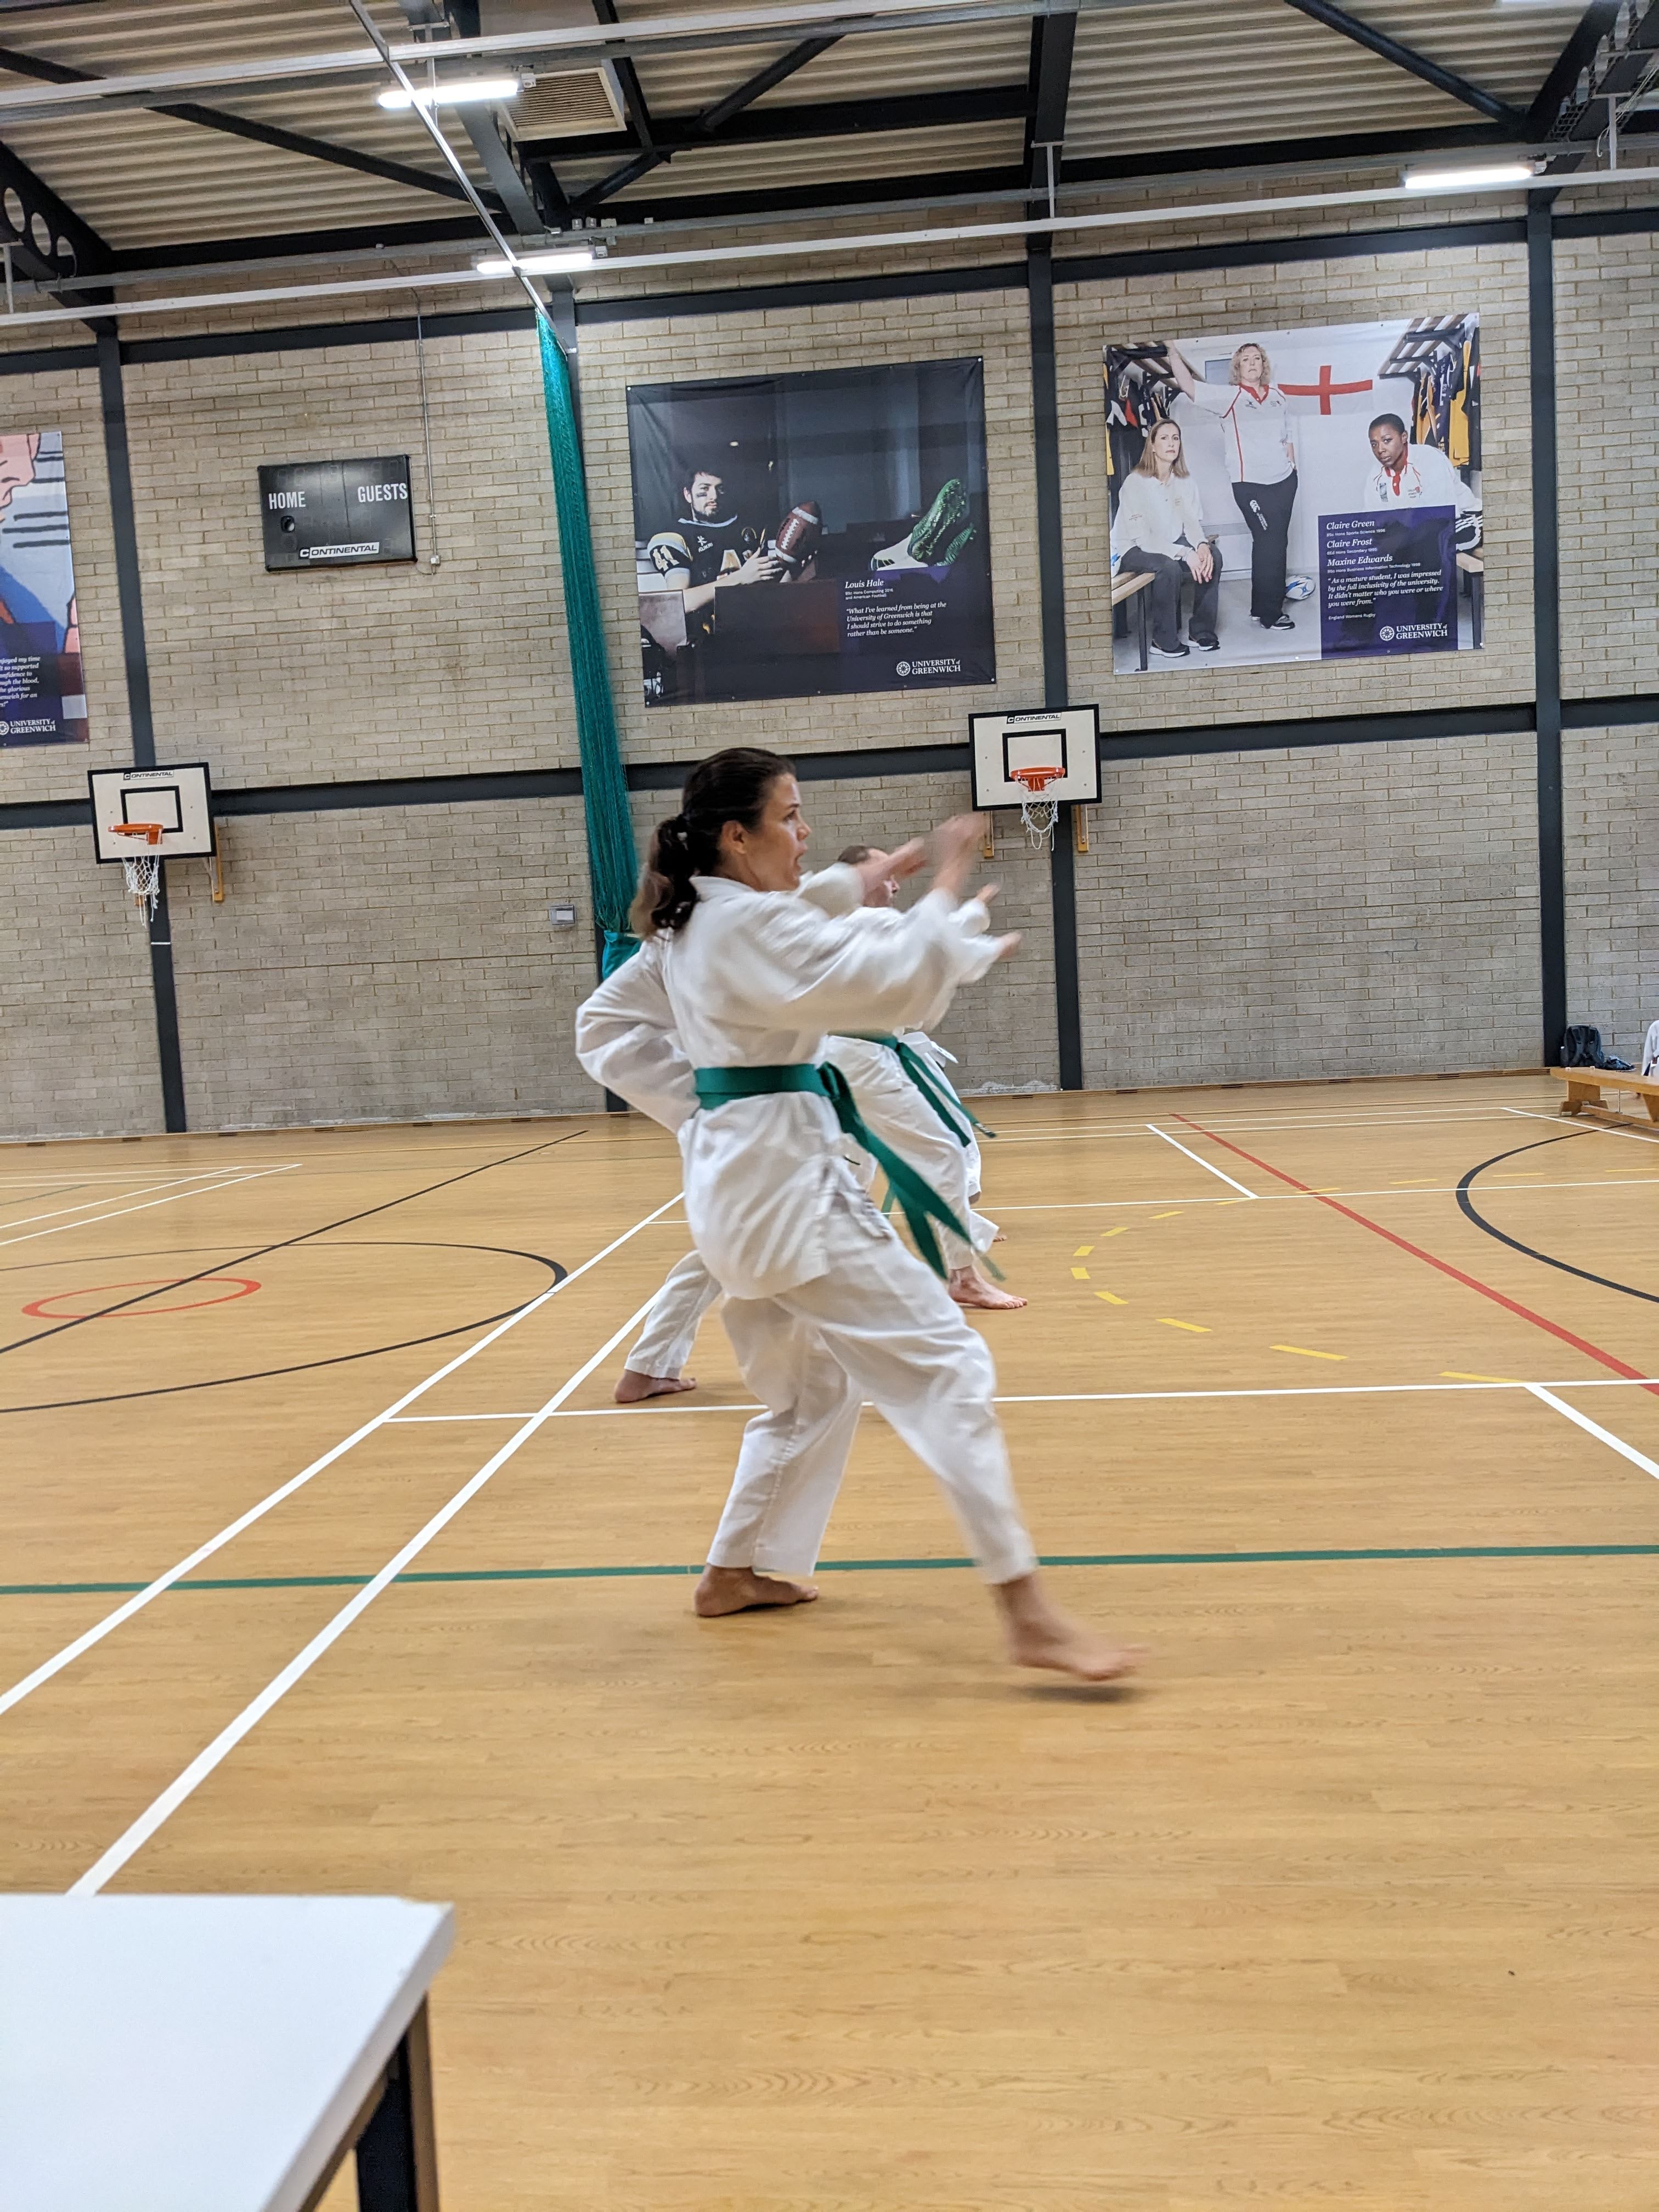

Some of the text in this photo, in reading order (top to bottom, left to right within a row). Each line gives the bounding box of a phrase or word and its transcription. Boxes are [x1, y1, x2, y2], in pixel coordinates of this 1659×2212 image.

[268, 483, 408, 510] HOME GUESTS
[1326, 521, 1350, 530] Claire
[1327, 538, 1373, 548] Claire Frost
[300, 544, 377, 558] CONTINENTAL
[1327, 554, 1393, 567] Maxine Edwards
[1411, 569, 1442, 578] impressed
[845, 578, 884, 589] Louis Hale
[1346, 583, 1357, 591] full
[876, 604, 898, 613] learned
[884, 611, 914, 619] Greenwich
[888, 626, 917, 634] someone."
[1396, 623, 1442, 632] UNIVERSITY
[1396, 629, 1448, 640] GREENWICH
[12, 662, 40, 672] supported
[912, 658, 956, 668] UNIVERSITY
[912, 664, 961, 675] GREENWICH
[10, 718, 51, 727] UNIVERSITY
[1007, 714, 1060, 724] CONTINENTAL
[10, 724, 56, 734] GREENWICH
